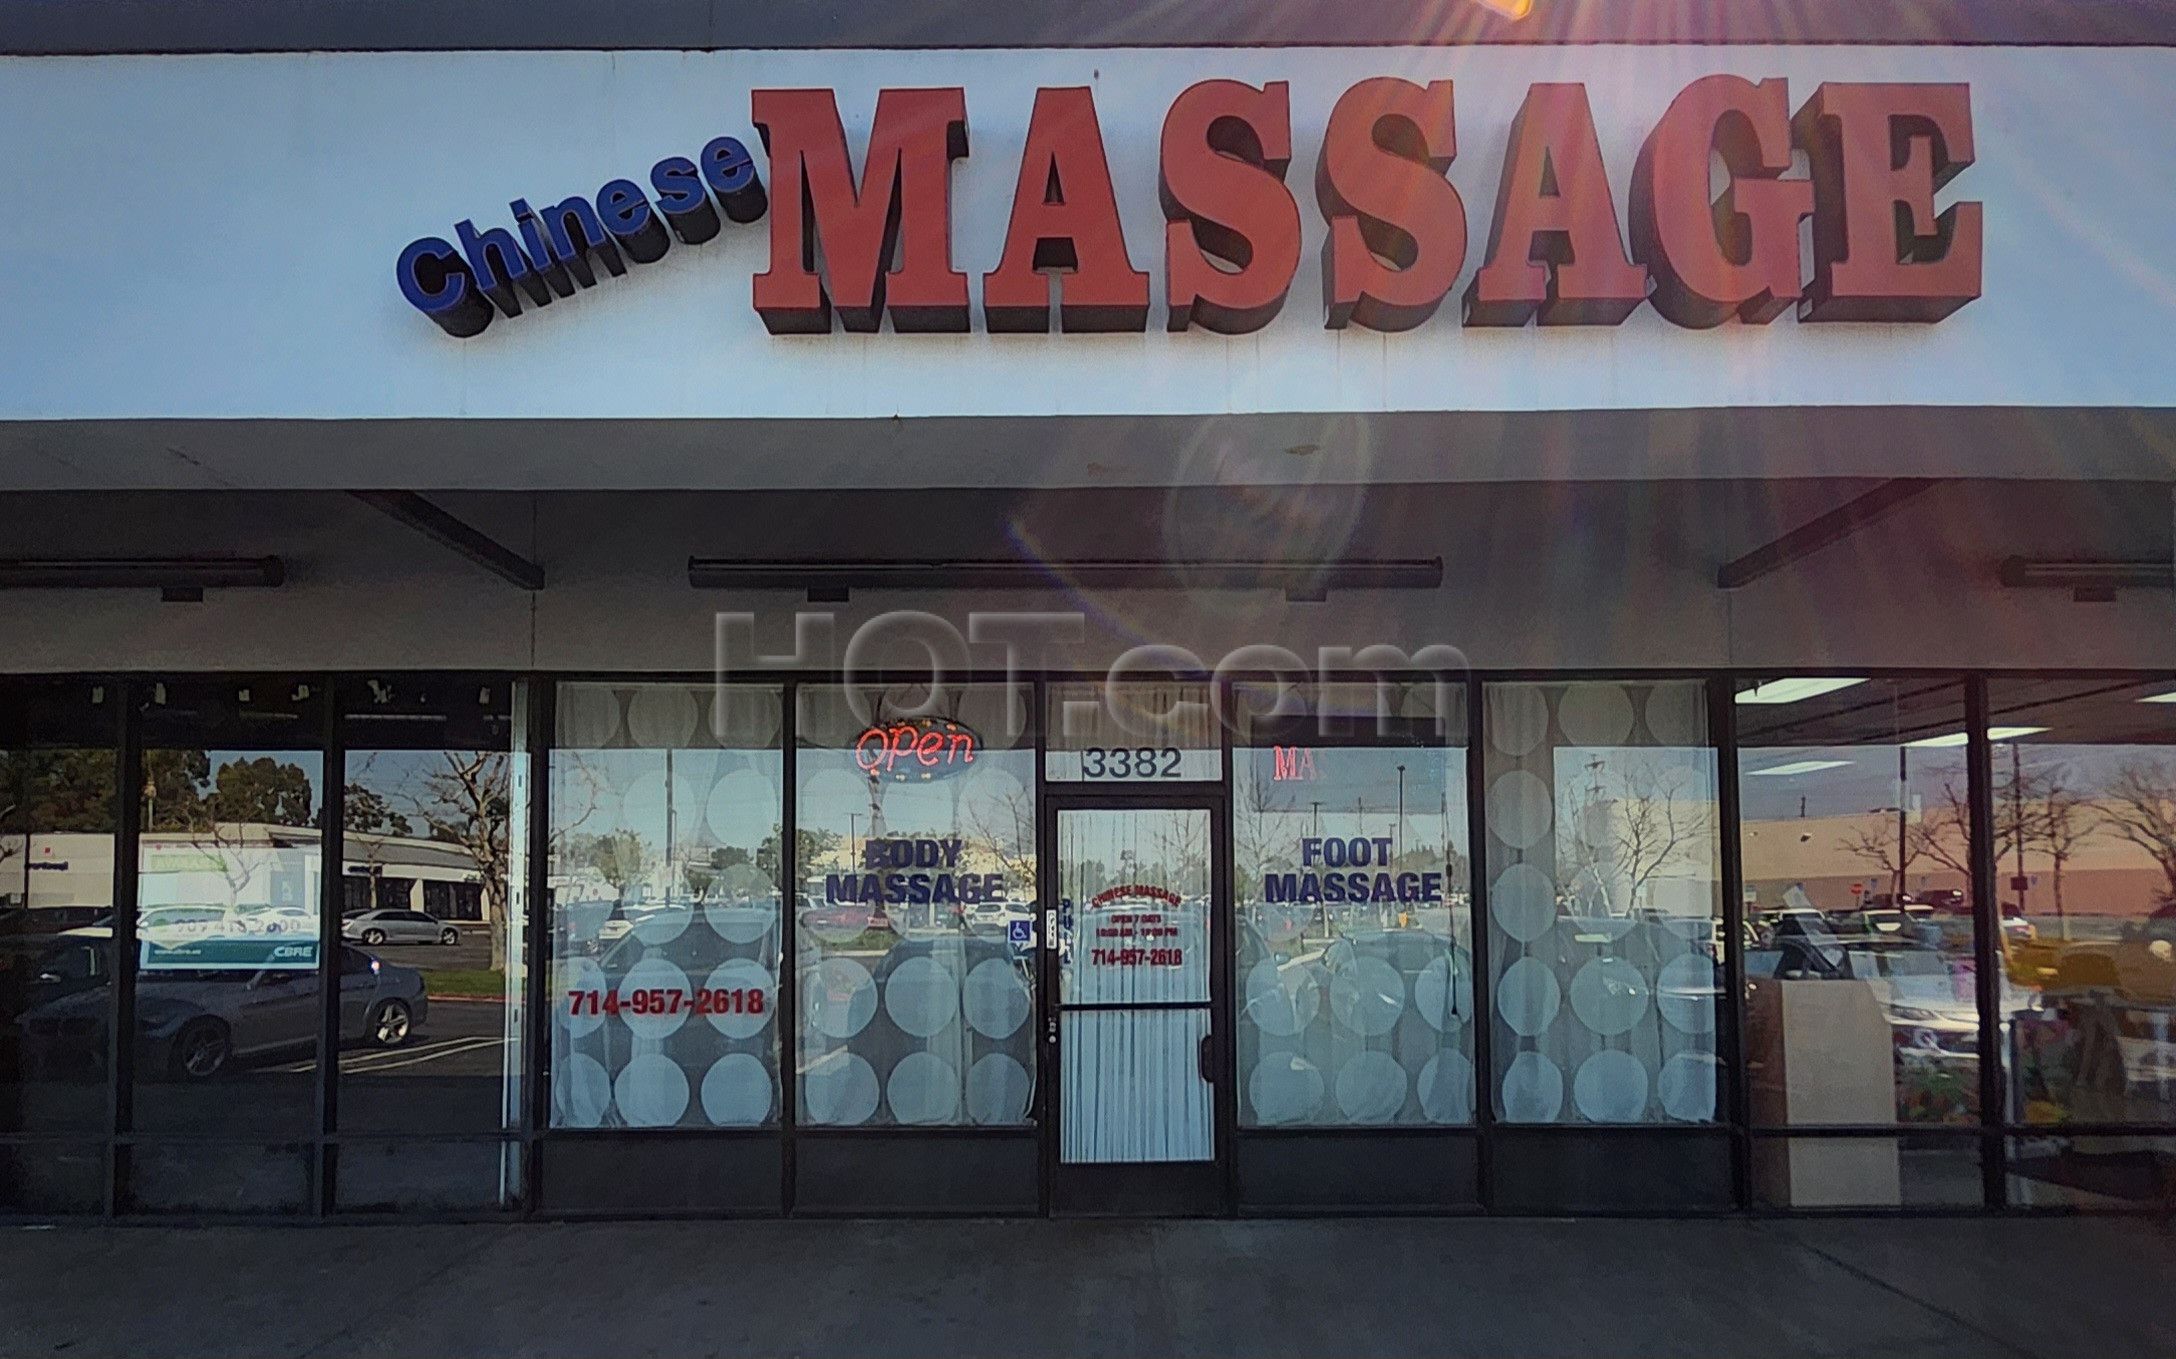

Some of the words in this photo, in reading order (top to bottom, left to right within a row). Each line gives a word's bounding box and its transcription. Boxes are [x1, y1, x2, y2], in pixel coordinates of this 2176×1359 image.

[397, 137, 768, 337] Chinese
[752, 74, 1983, 334] MASSAGE
[1082, 747, 1182, 779] 3382
[865, 839, 962, 869] BODY
[1302, 837, 1393, 867] FOOT
[826, 874, 1004, 904] MASSAGE
[1134, 885, 1182, 908] MASSAGE
[1265, 872, 1442, 903] MASSAGE
[273, 946, 313, 957] CBRE
[1091, 948, 1182, 966] 714-957-2618
[568, 988, 764, 1016] 714-957-2618
